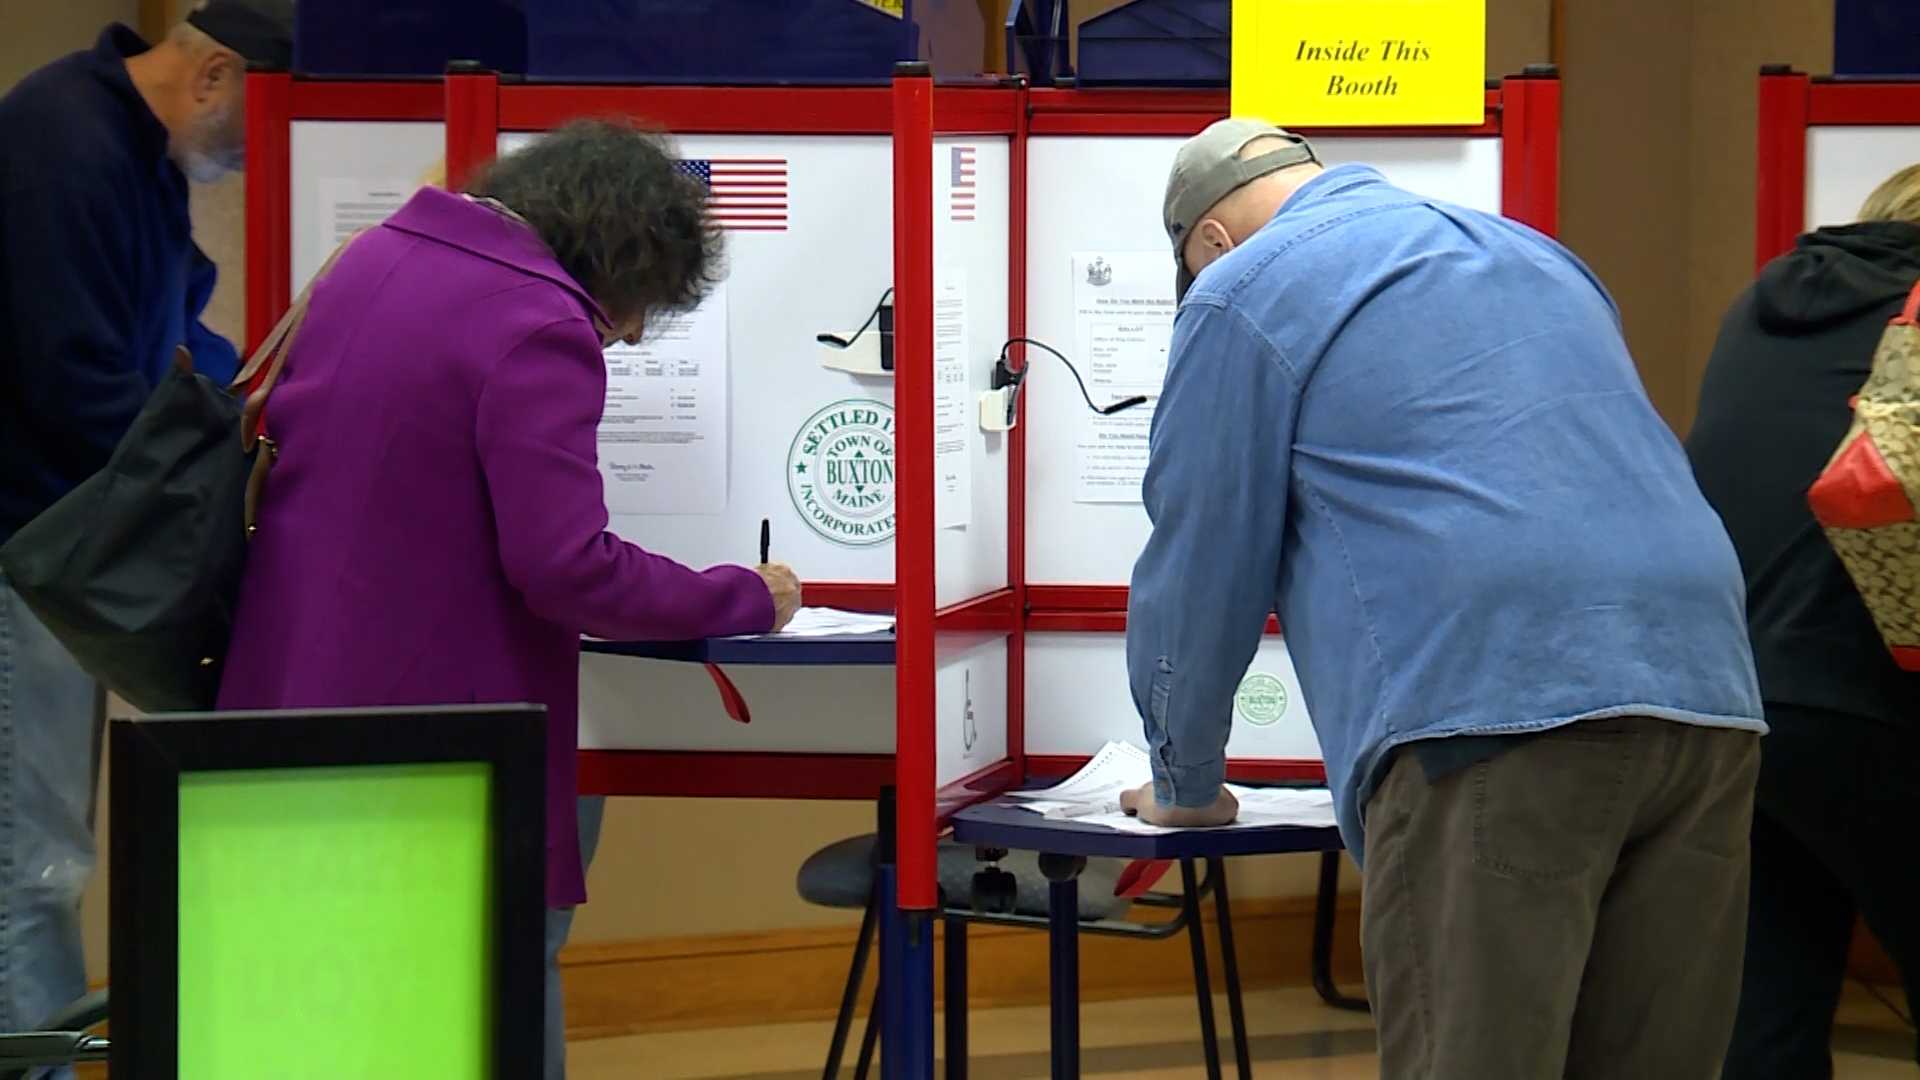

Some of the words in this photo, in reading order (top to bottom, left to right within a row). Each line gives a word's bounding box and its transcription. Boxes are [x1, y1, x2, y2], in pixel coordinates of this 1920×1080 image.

[1296, 40, 1370, 62] Inside
[1381, 40, 1432, 62] This
[1326, 75, 1398, 96] Booth
[802, 409, 879, 456] SETTLED
[826, 435, 872, 458] TOWN
[826, 459, 894, 485] BUXTON
[832, 488, 885, 508] MAINE
[801, 484, 896, 536] INCORPORATE
